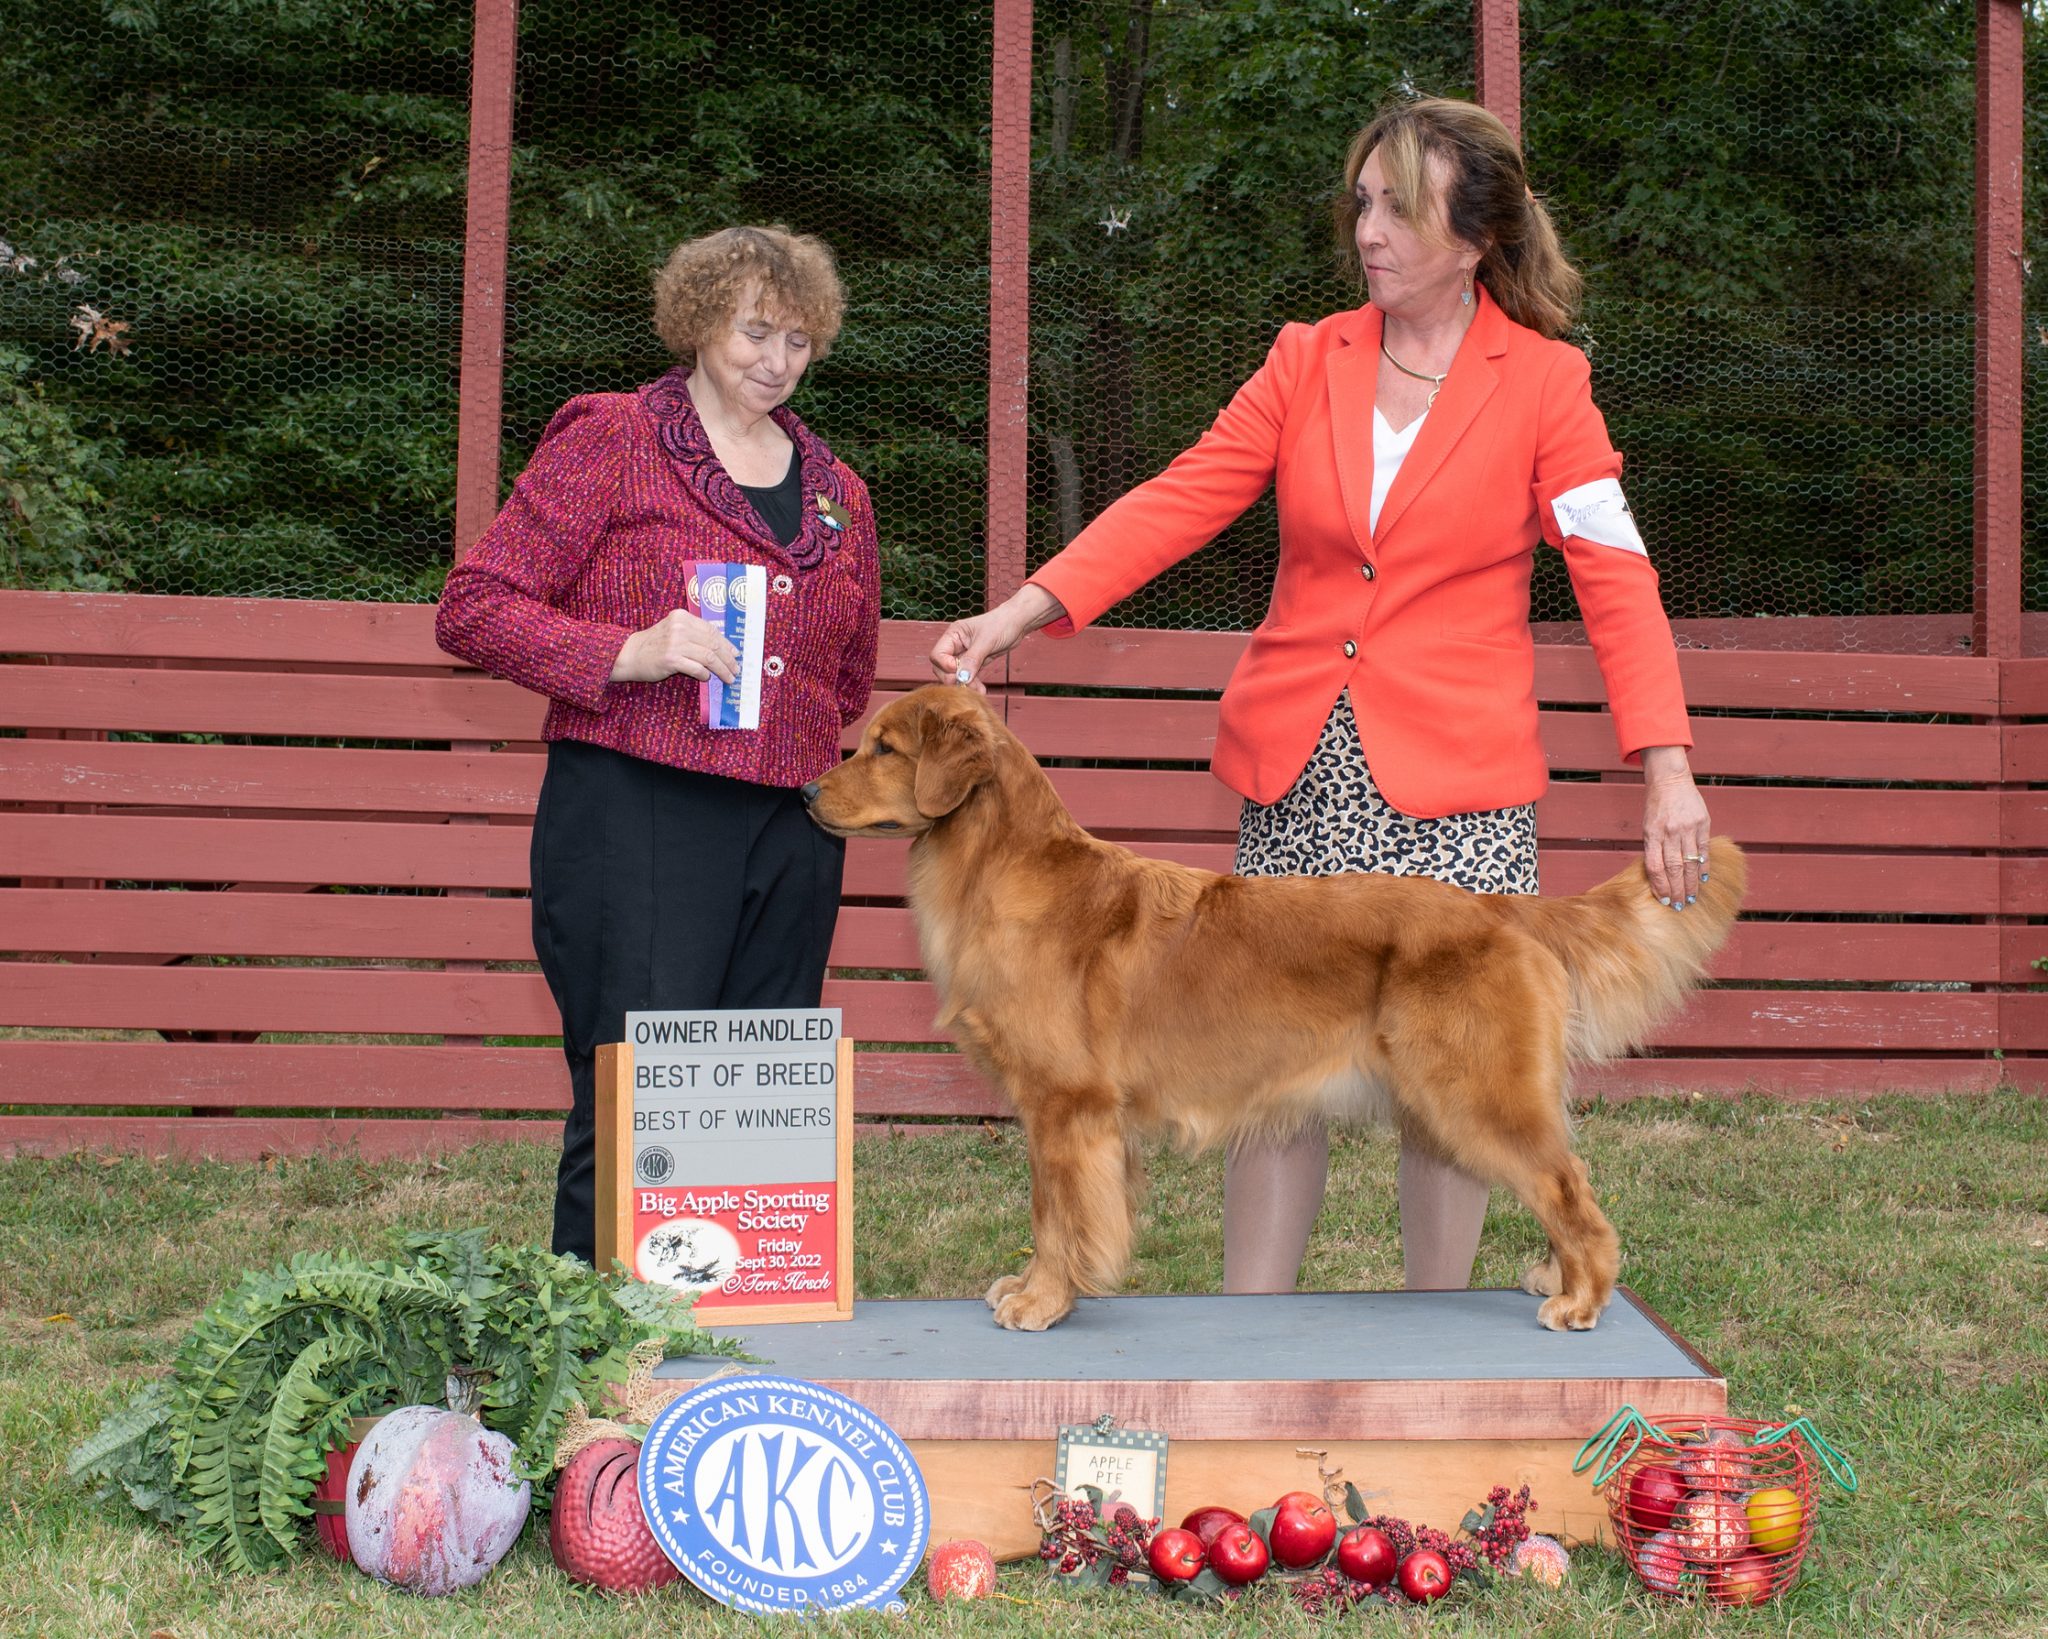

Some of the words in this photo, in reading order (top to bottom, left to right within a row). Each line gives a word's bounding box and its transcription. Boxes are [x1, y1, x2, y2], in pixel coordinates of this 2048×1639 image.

[635, 1020, 717, 1044] OWNER
[728, 1018, 833, 1042] HANDLED
[636, 1065, 701, 1088] BEST
[713, 1064, 744, 1087] OF
[756, 1062, 835, 1086] BREED
[634, 1111, 691, 1131] BEST
[699, 1109, 726, 1129] OF
[735, 1107, 832, 1128] WINNERS
[640, 1192, 677, 1216] Big
[680, 1191, 740, 1215] Apple
[744, 1190, 830, 1213] Sporting
[738, 1211, 809, 1233] Society
[758, 1238, 802, 1255] Friday
[735, 1256, 767, 1271] Sept
[768, 1255, 788, 1270] 30,
[790, 1254, 822, 1267] 2022
[782, 1271, 832, 1291] Hirsch
[663, 1395, 760, 1497] AMERICAN
[767, 1395, 878, 1460] KENNEL
[873, 1460, 906, 1528] CLUB
[1089, 1455, 1134, 1470] APPLE
[1096, 1471, 1124, 1485] PIE
[705, 1430, 862, 1571] AKC
[697, 1549, 808, 1603] FOUNDED
[820, 1573, 869, 1602] 1884
